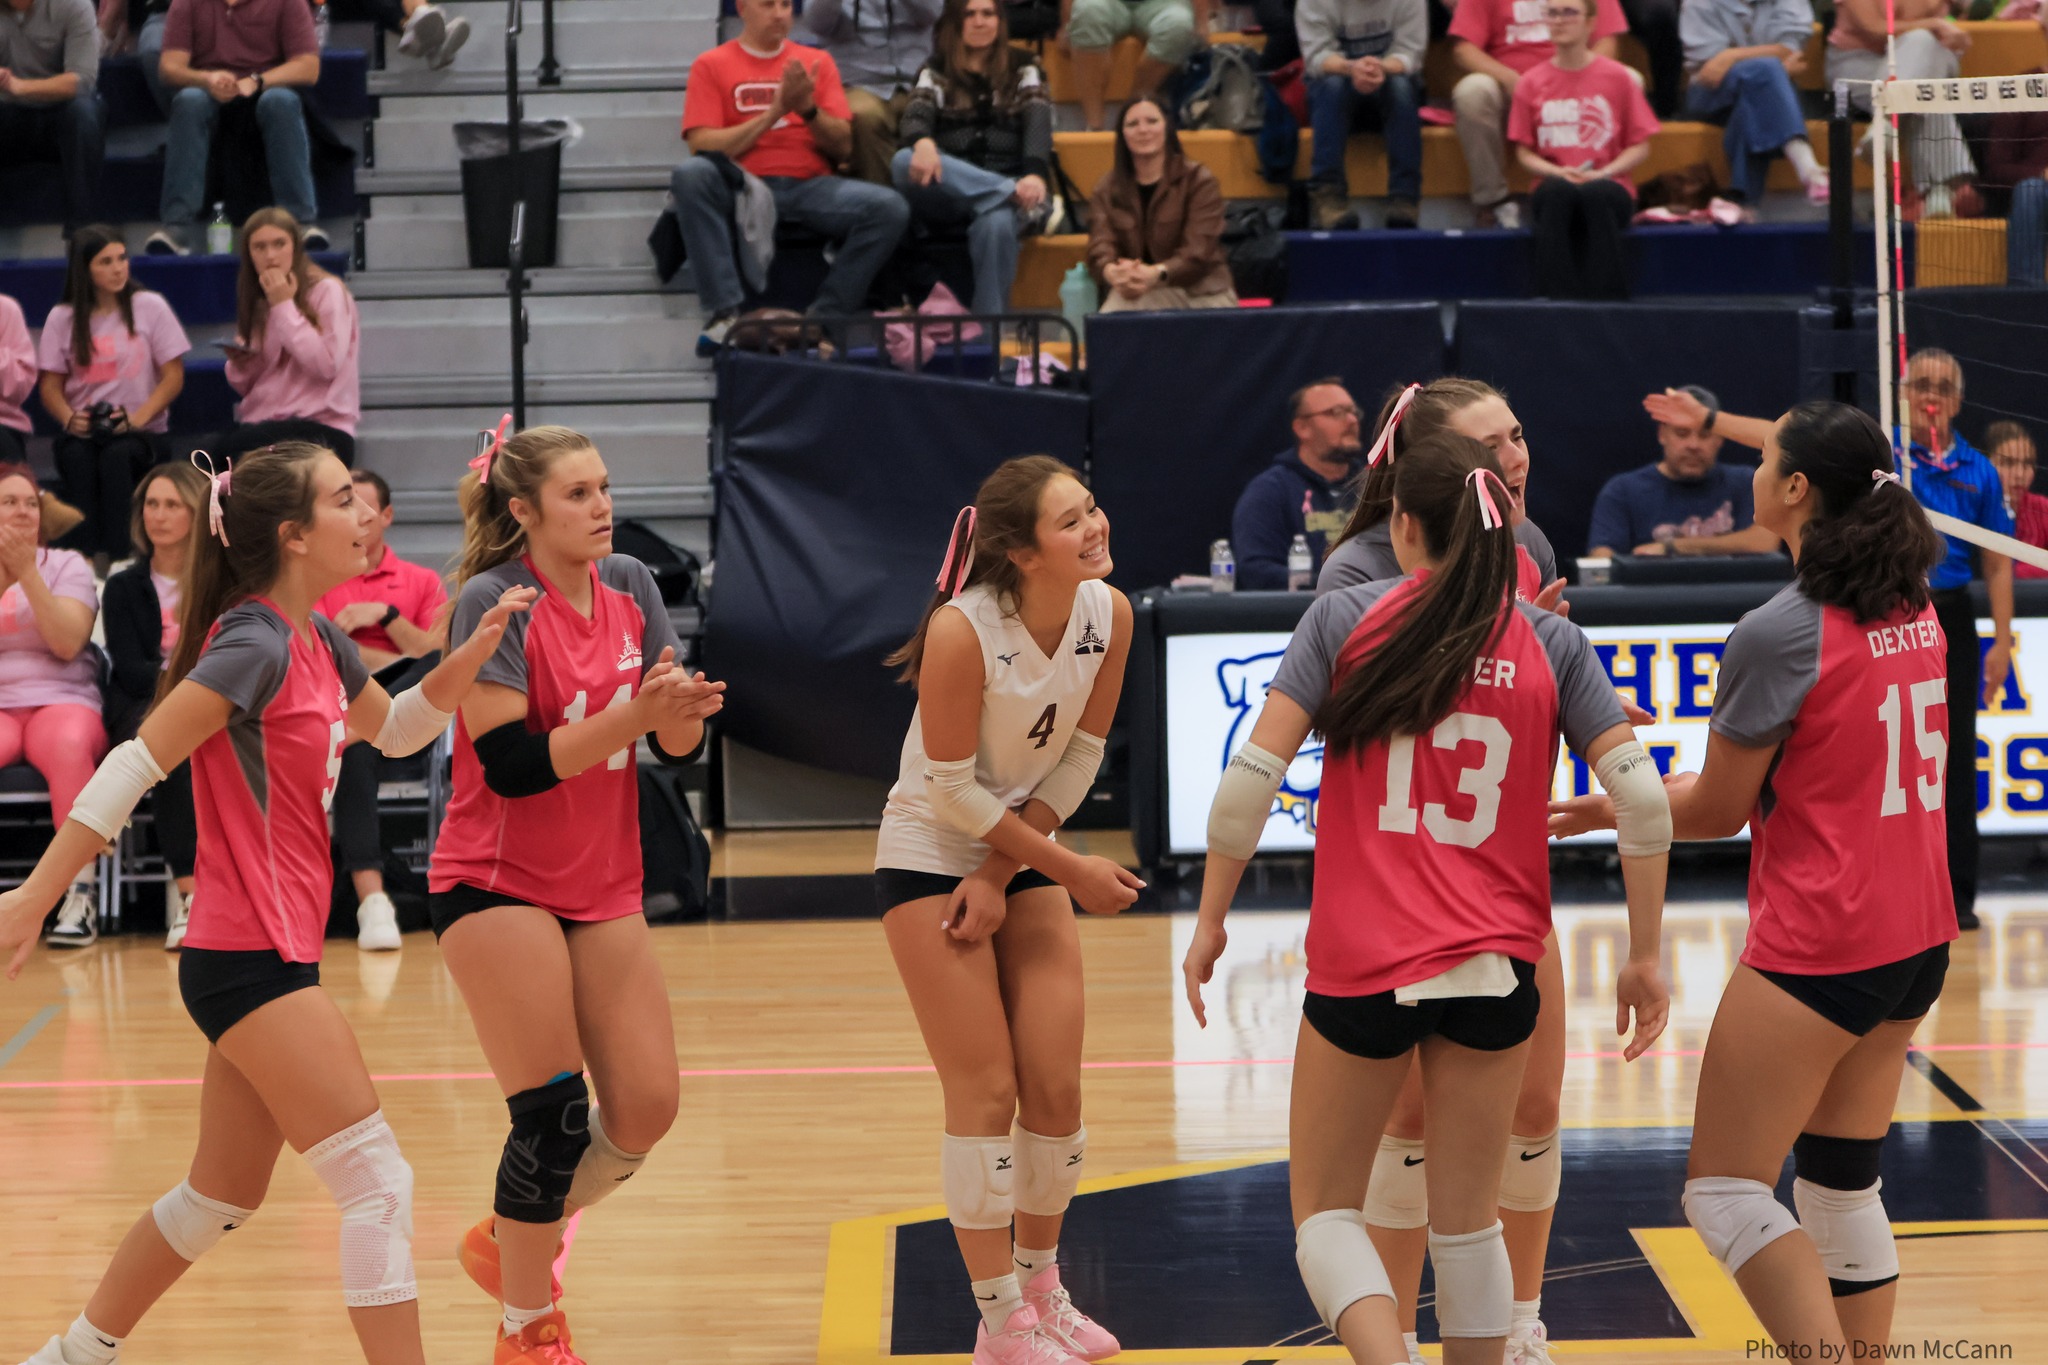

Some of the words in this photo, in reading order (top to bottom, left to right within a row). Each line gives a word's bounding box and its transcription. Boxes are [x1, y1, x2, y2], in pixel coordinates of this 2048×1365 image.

[1867, 619, 1939, 658] DEXTER
[1027, 703, 1057, 749] 4
[1878, 677, 1947, 817] 15
[1378, 711, 1513, 849] 13
